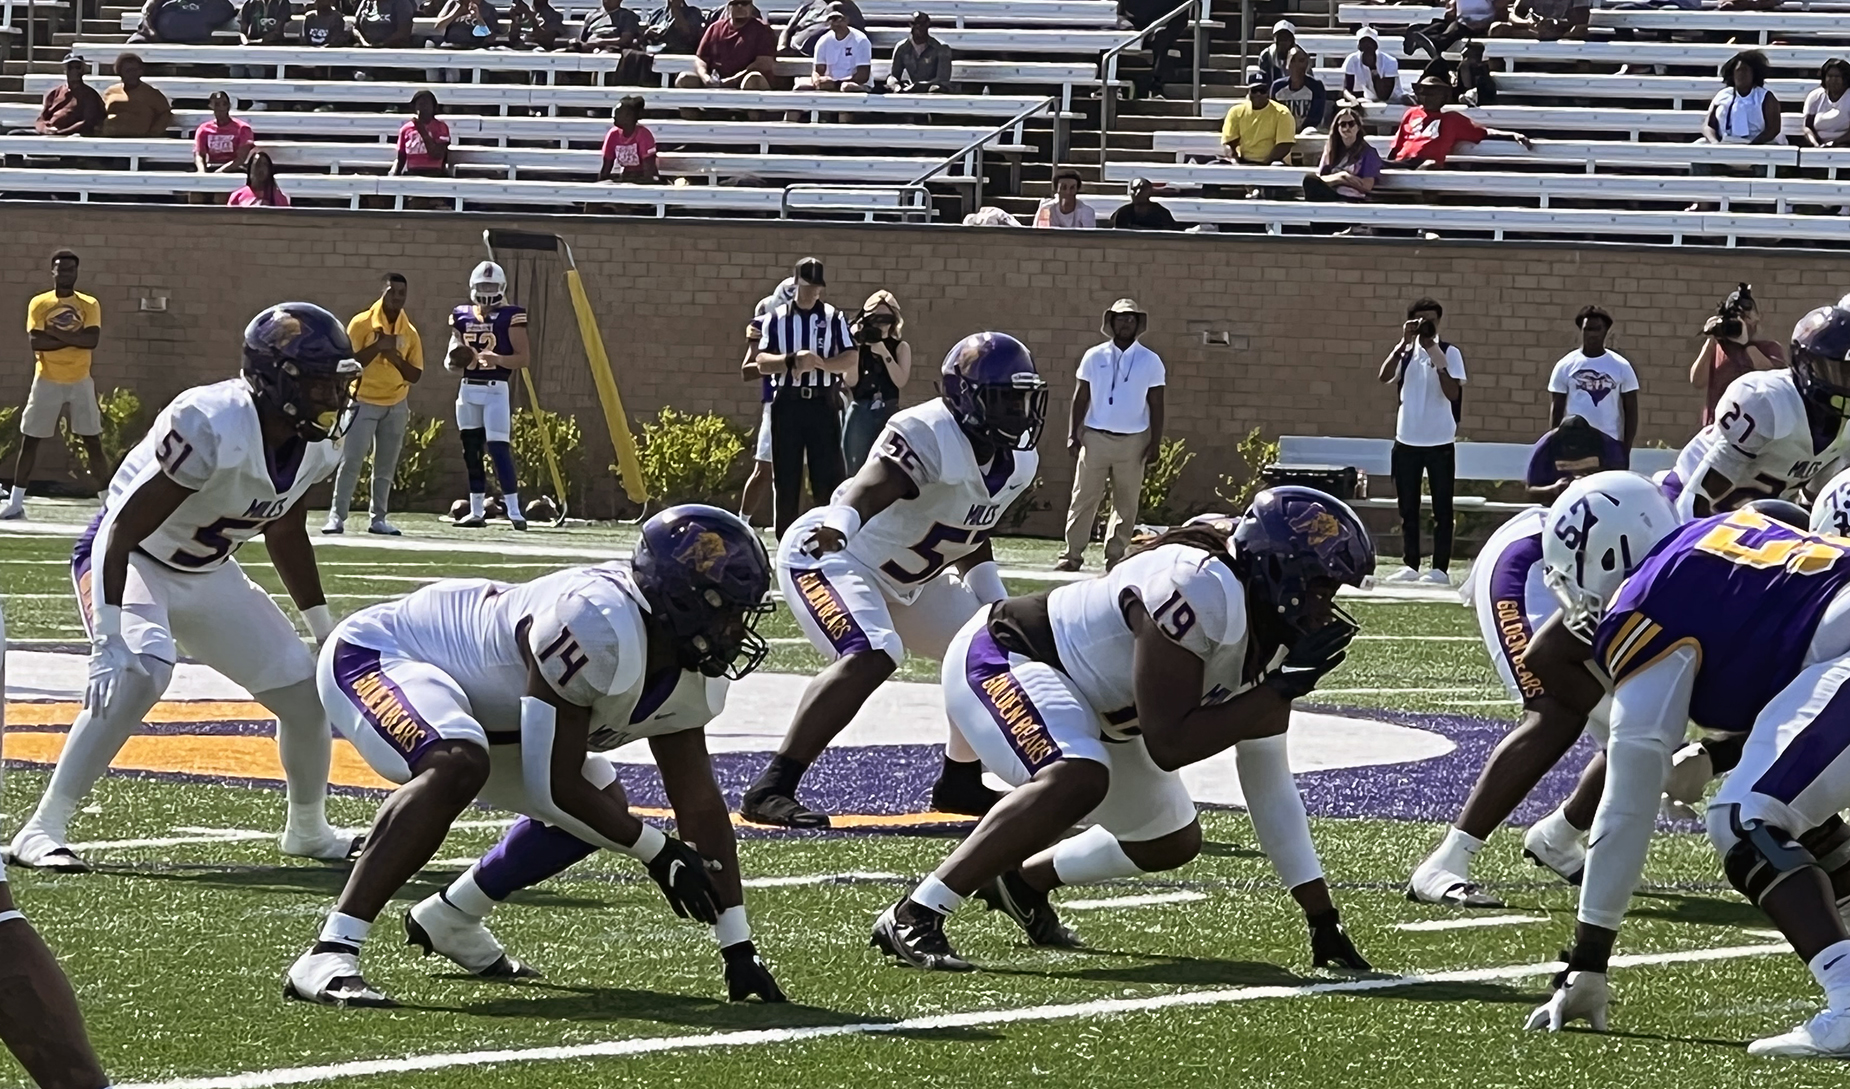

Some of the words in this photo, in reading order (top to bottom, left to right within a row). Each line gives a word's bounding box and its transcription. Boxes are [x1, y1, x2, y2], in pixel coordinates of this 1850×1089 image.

[1720, 402, 1756, 444] 27
[156, 429, 193, 475] 51
[1554, 496, 1592, 550] 57
[1153, 589, 1196, 641] 19
[538, 626, 589, 687] 14
